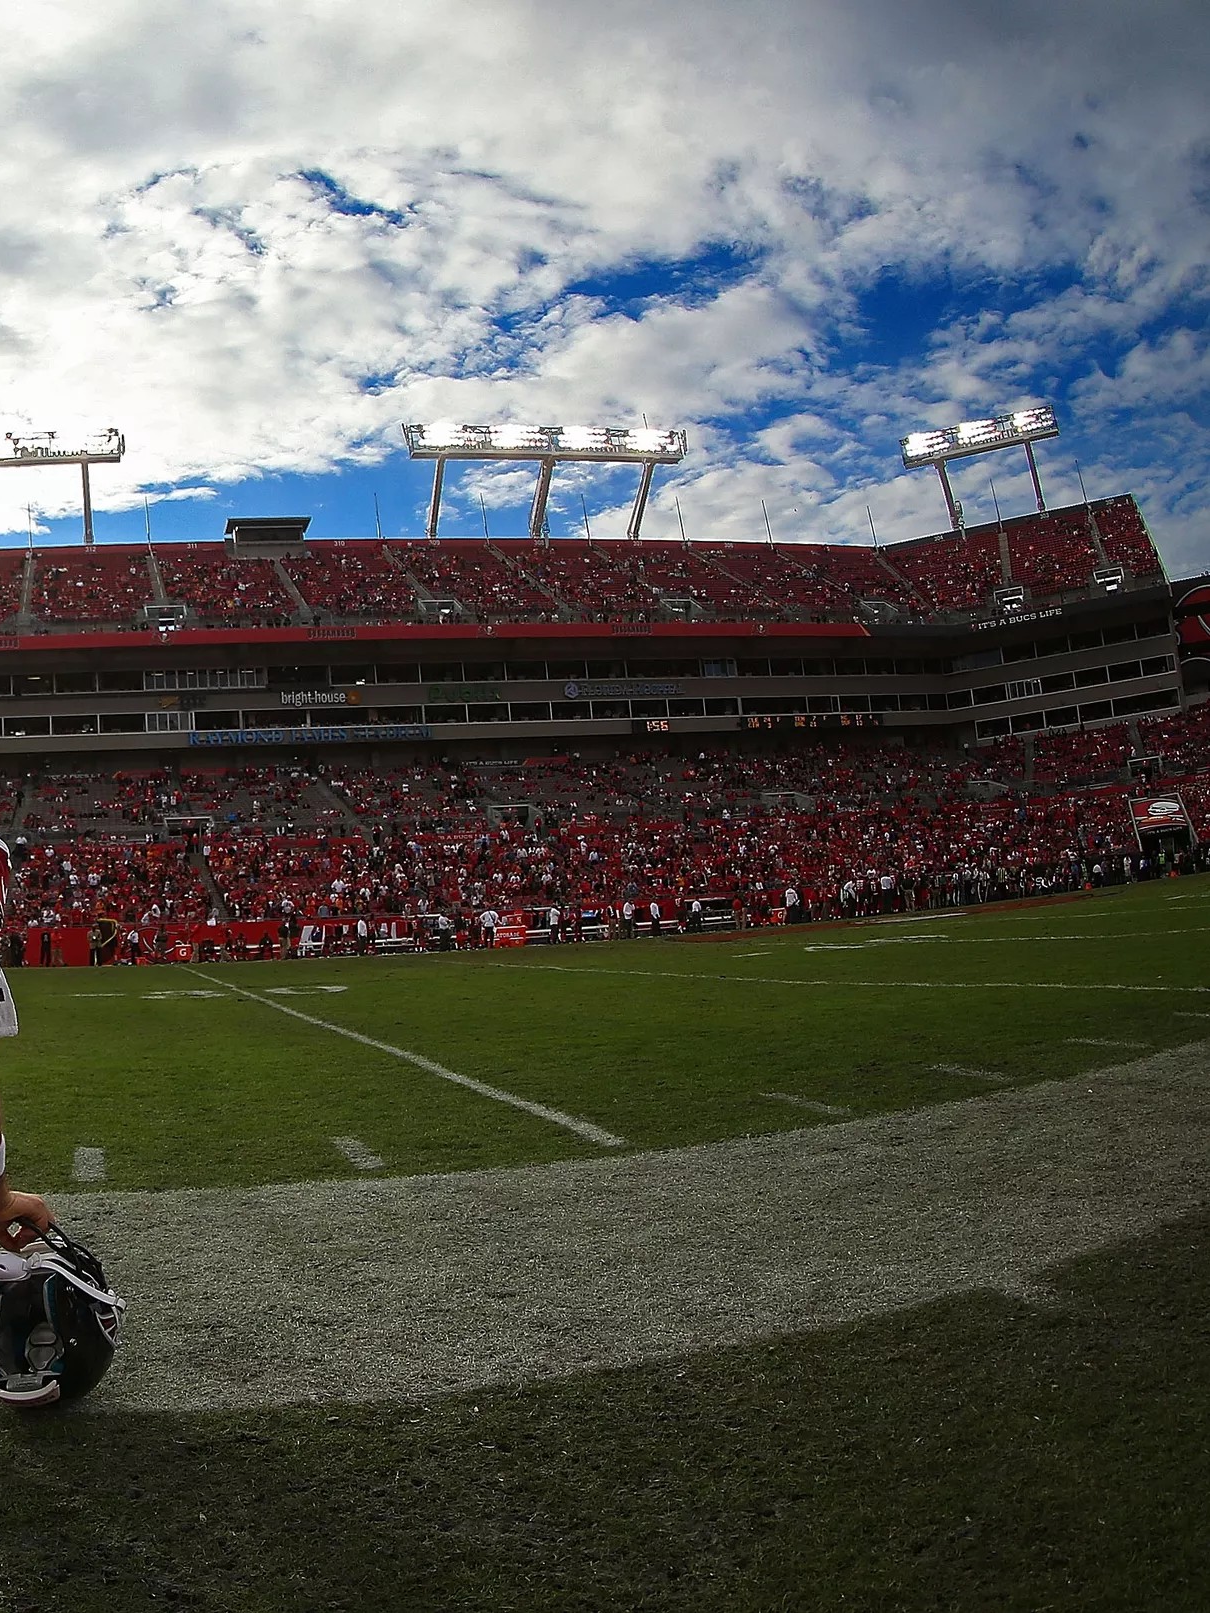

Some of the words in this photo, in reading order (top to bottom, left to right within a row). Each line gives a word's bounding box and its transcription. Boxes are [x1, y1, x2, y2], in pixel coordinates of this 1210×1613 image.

[978, 620, 997, 630] IT'S
[999, 618, 1007, 626] A
[1009, 612, 1037, 624] BUCS
[1039, 608, 1063, 618] LIFE
[190, 730, 284, 746] RAYMOND
[179, 948, 187, 957] G
